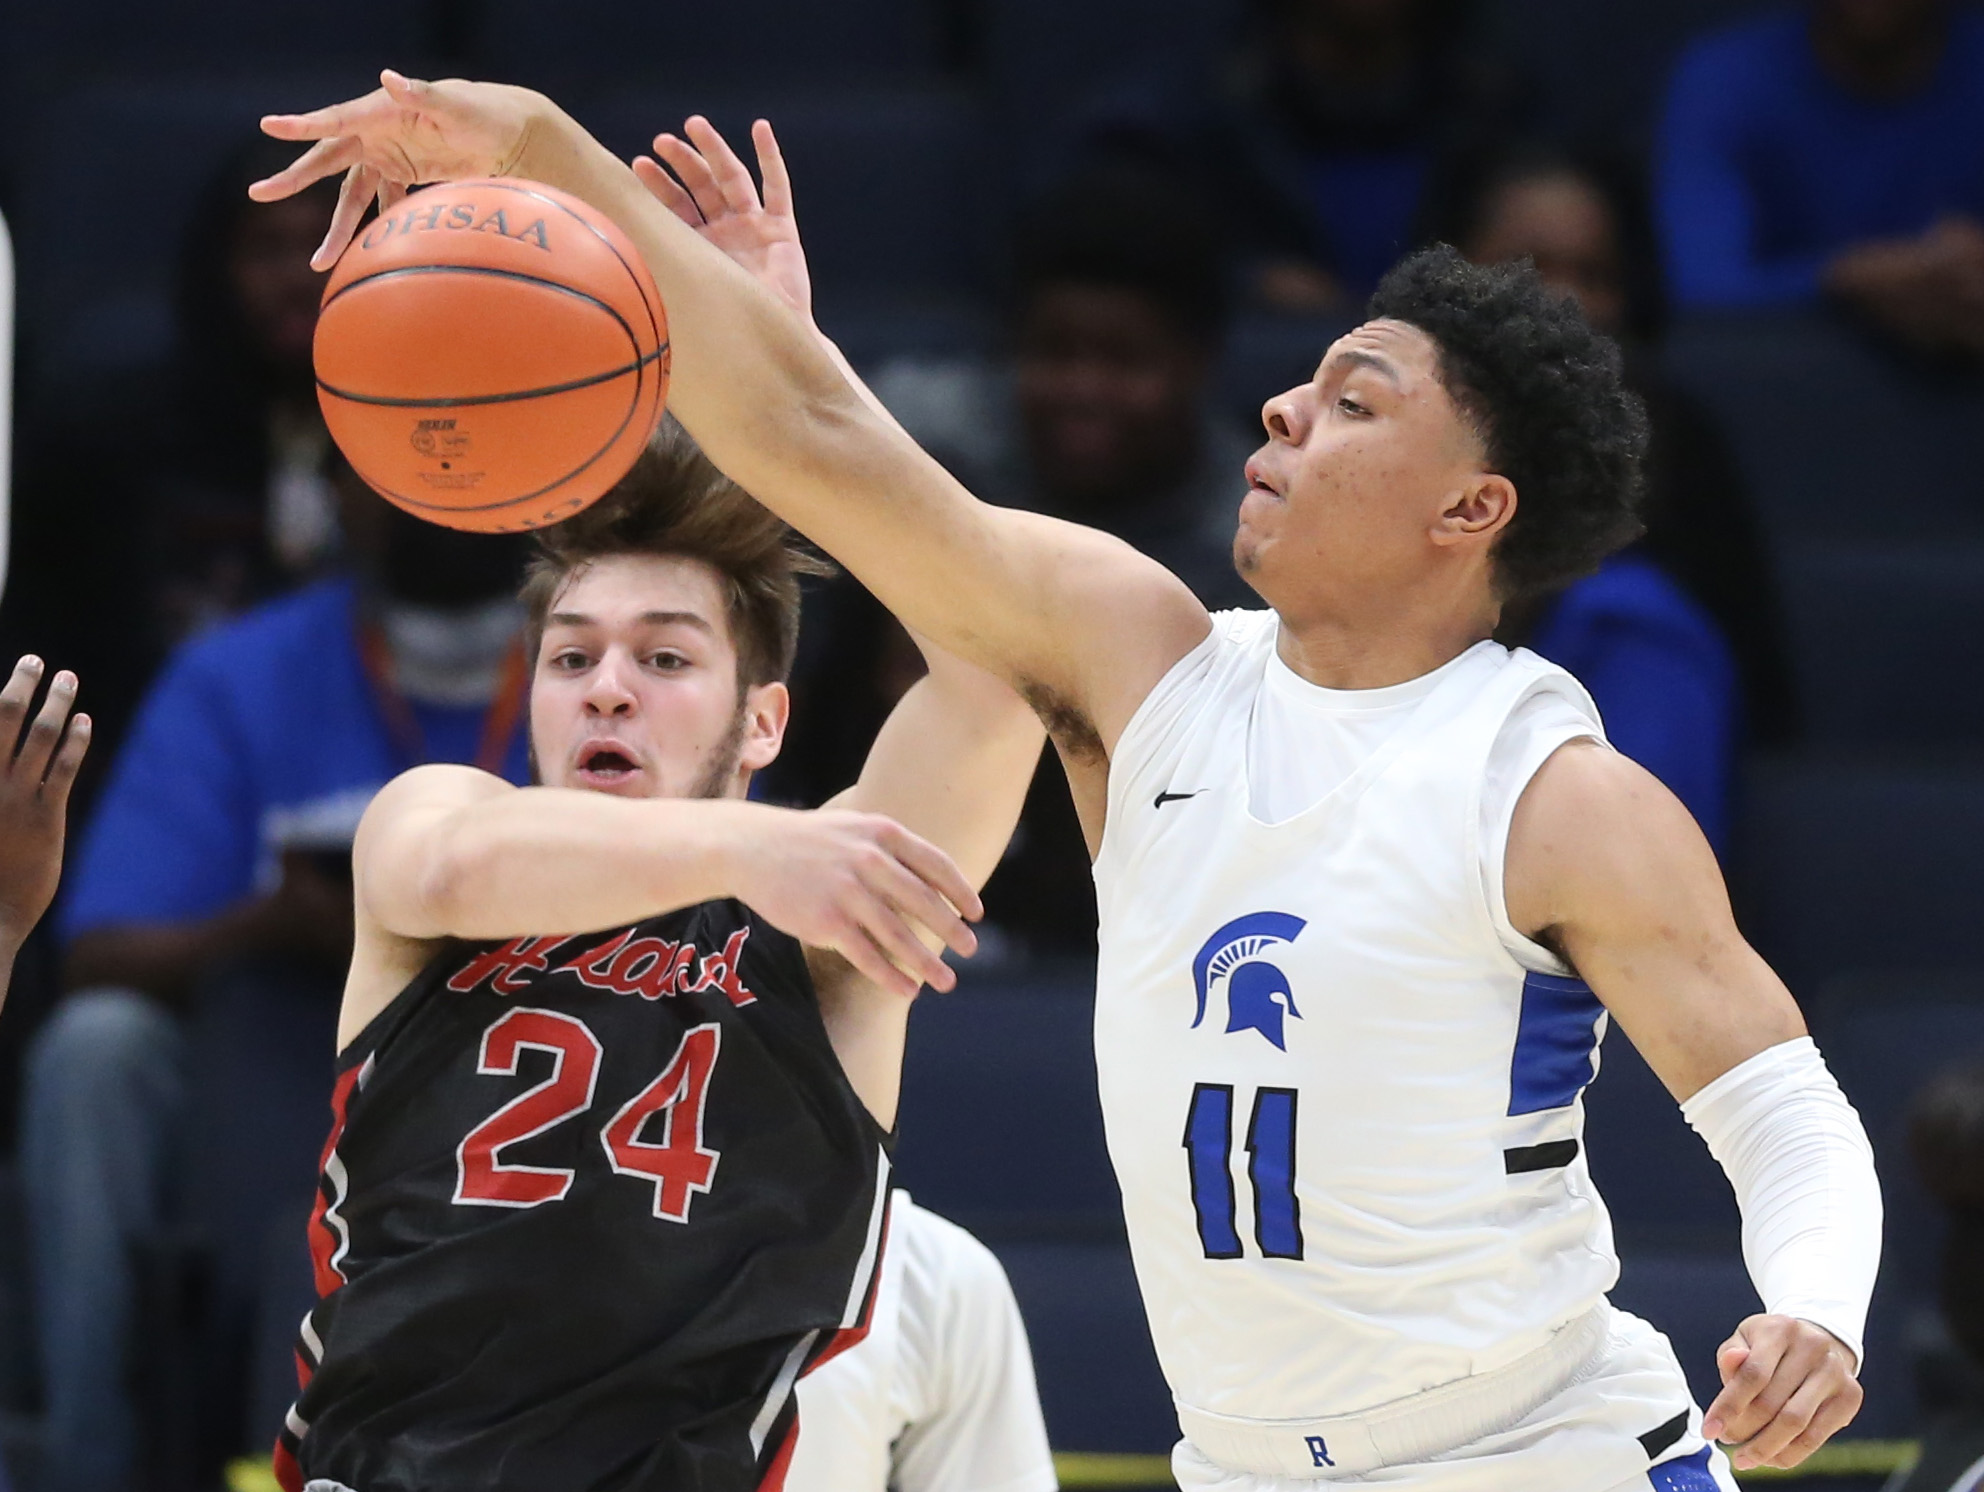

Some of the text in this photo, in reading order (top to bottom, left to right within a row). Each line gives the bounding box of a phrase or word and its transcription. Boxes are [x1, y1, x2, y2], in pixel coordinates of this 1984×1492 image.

[361, 203, 551, 253] OHSAA
[450, 1005, 722, 1225] 24
[1182, 1081, 1304, 1261] 11
[1303, 1435, 1336, 1467] R
